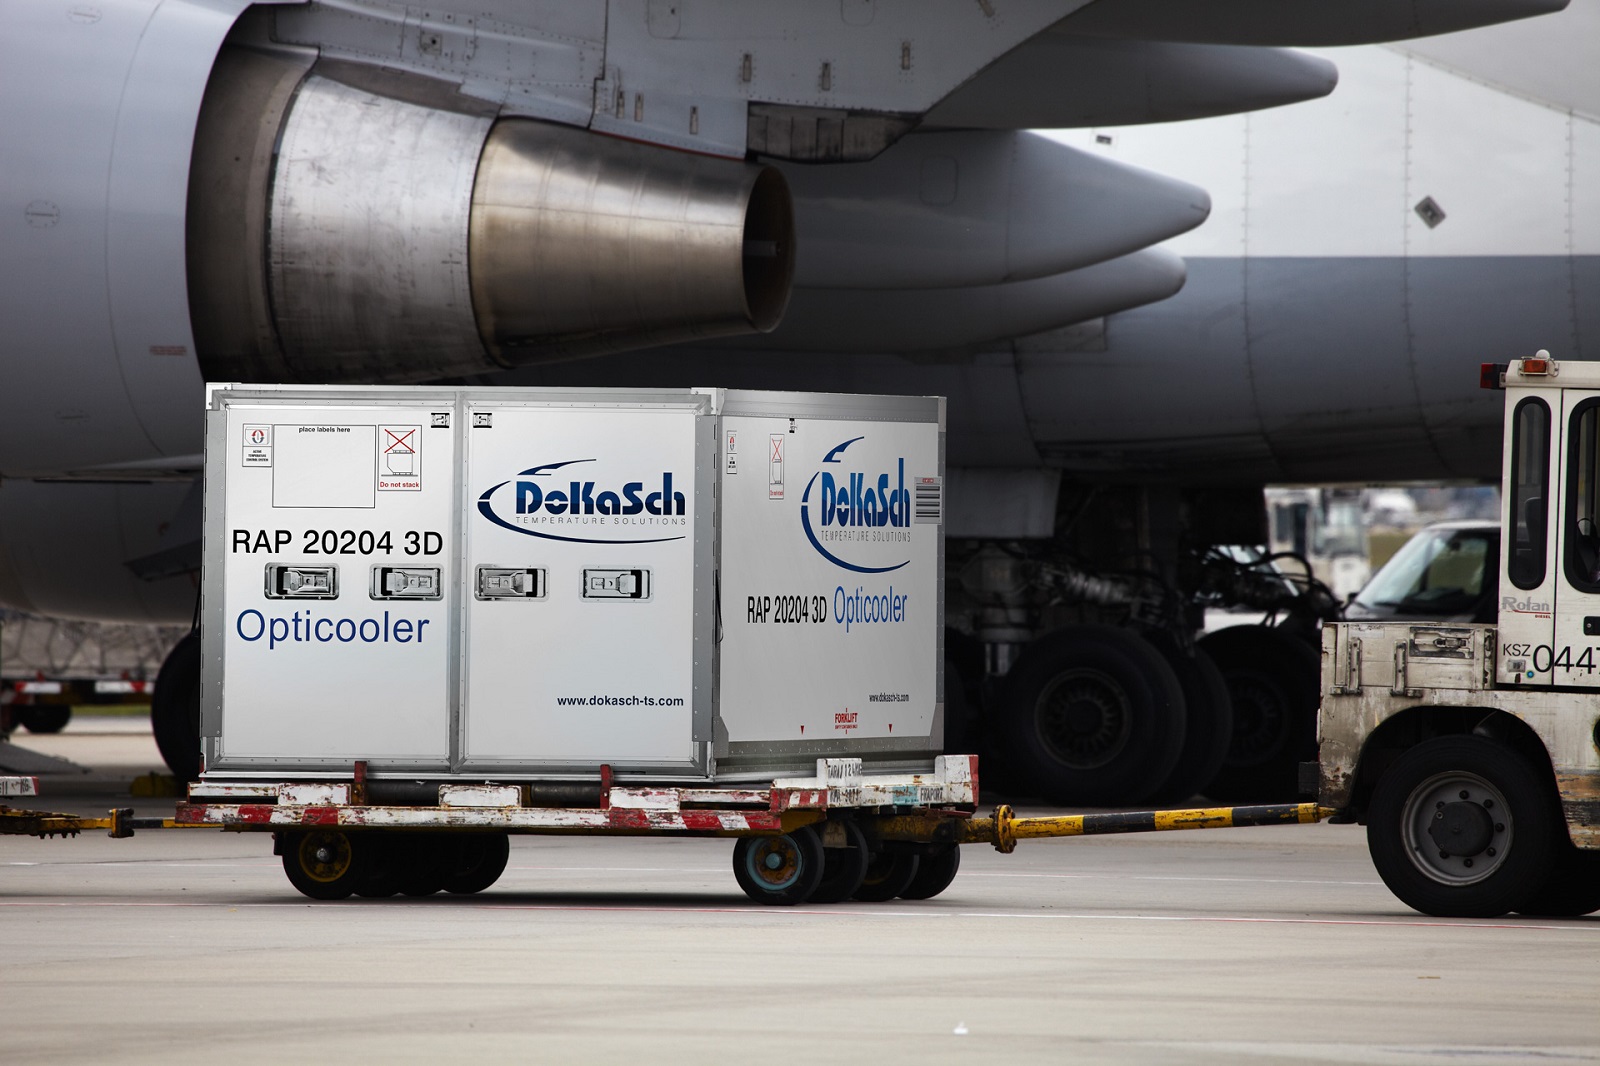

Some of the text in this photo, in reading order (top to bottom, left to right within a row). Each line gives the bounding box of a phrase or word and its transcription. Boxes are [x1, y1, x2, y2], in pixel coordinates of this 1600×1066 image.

[516, 472, 686, 515] DoKaSch
[821, 457, 910, 527] DoKaSch
[516, 516, 686, 526] TEMPERATURE SOLUTIONS
[232, 529, 443, 556] RAP 20204 3D
[821, 530, 911, 543] TEMPERATURE SOLUTIONS
[747, 595, 828, 624] RAP 20204 3D
[834, 585, 908, 633] Opticooler
[236, 609, 430, 650] Opticooler
[1503, 643, 1600, 674] KSZ 044
[557, 695, 684, 707] www.dokasch-ts.com
[834, 712, 858, 723] FORKLIFT
